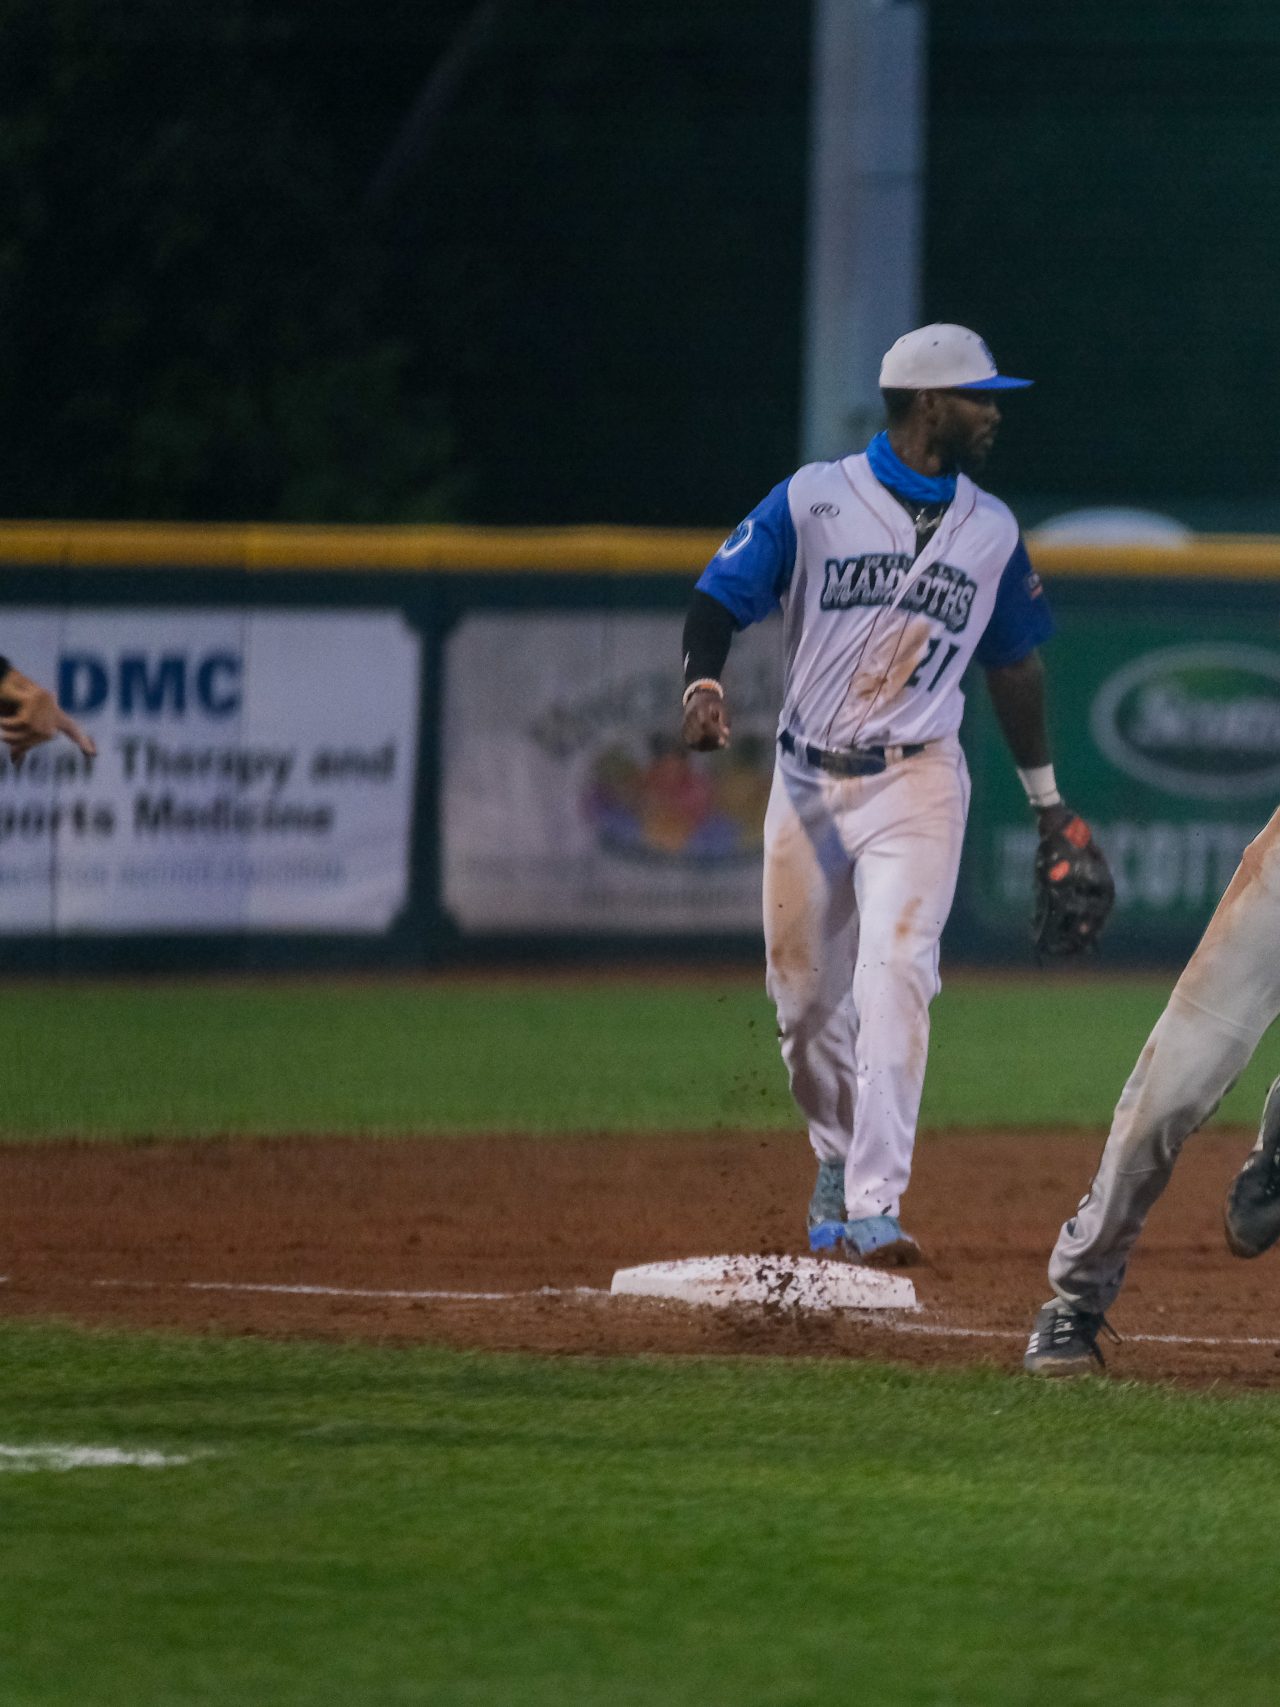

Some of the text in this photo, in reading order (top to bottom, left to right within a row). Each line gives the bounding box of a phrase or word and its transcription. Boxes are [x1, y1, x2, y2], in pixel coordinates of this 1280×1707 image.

[57, 648, 241, 720] DMC
[118, 738, 297, 800] Therapy
[310, 740, 396, 784] and
[132, 795, 334, 838] Medicine
